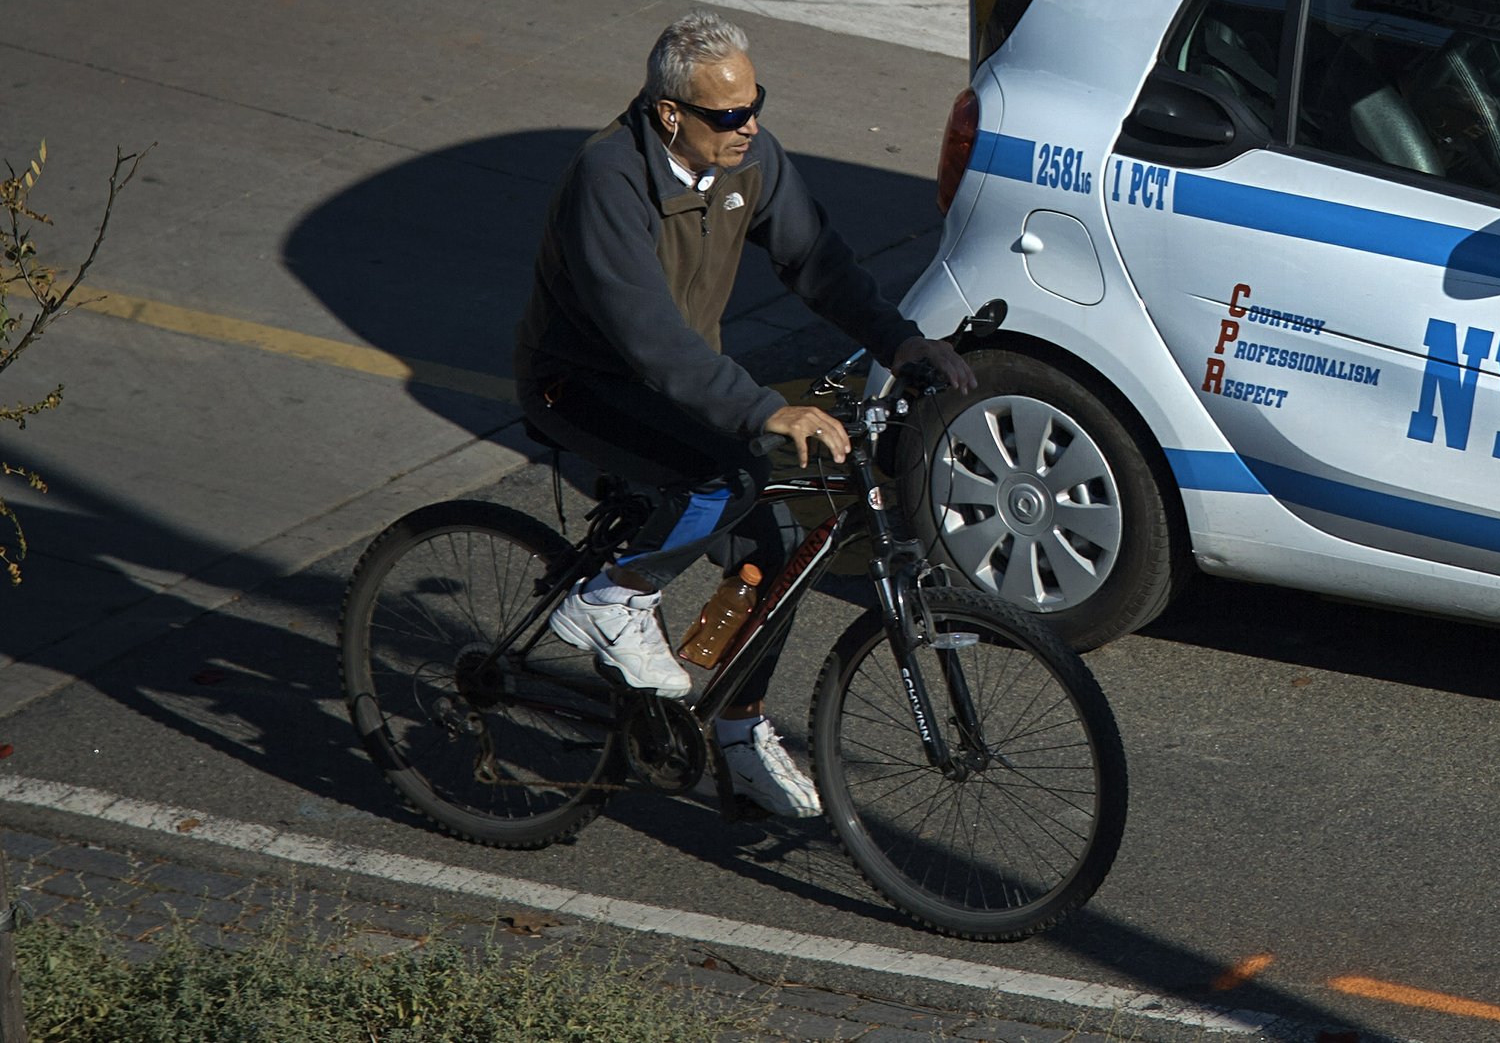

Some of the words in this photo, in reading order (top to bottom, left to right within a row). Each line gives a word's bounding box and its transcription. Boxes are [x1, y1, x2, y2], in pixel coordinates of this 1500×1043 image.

[1128, 162, 1170, 210] PCT
[1229, 283, 1326, 335] COURTESY
[1214, 319, 1381, 386] PROFESSIONALISM
[1201, 357, 1288, 408] RESPECT
[902, 668, 931, 742] SCHWINN
